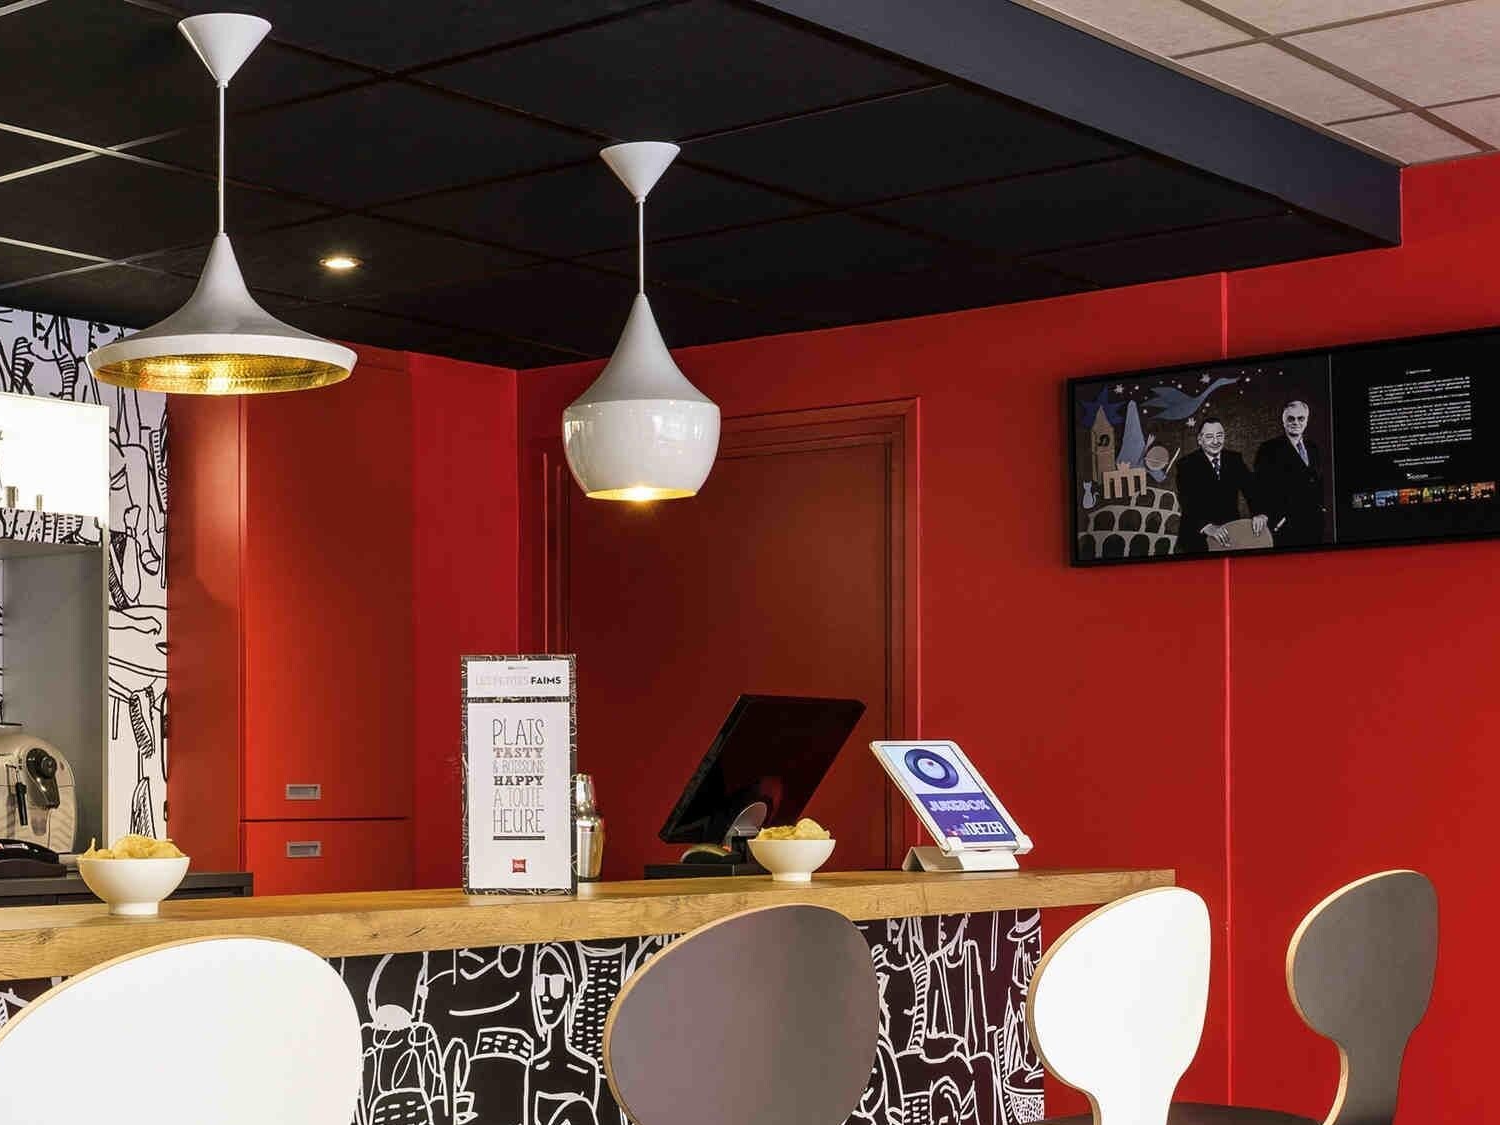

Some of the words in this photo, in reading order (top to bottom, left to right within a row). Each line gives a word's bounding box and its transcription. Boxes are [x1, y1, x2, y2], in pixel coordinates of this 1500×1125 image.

[530, 676, 562, 686] FAIMS
[492, 718, 545, 746] PLATS
[492, 747, 544, 758] TASTY
[502, 760, 545, 774] BOISSONS
[493, 775, 544, 786] HAPPY
[508, 787, 544, 808] TOUTE
[493, 808, 545, 833] HEURE
